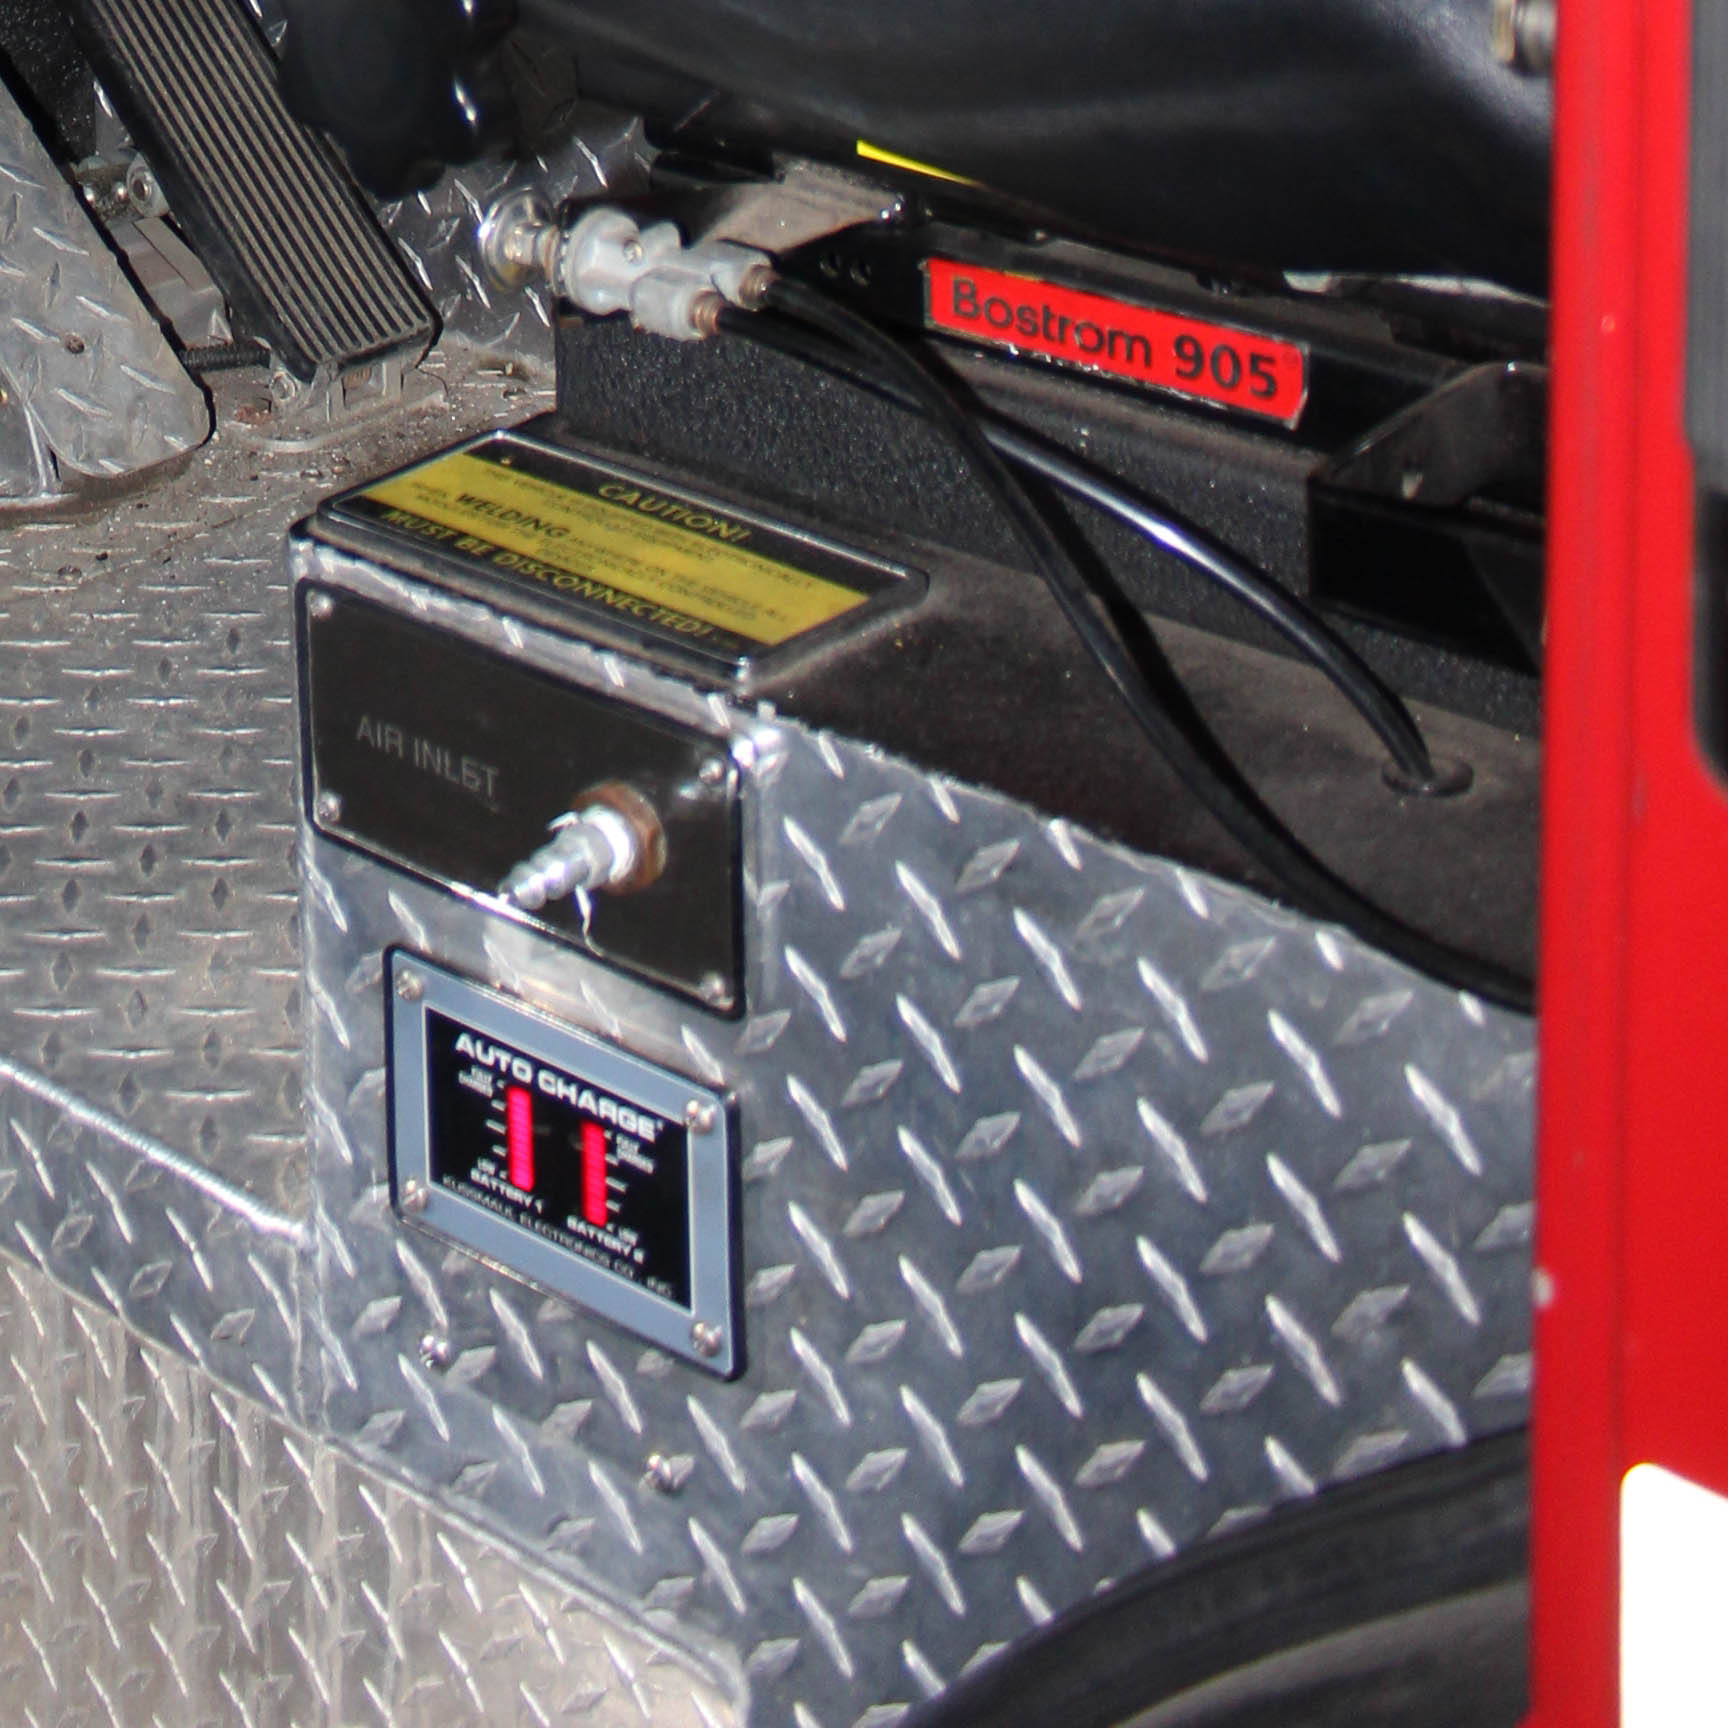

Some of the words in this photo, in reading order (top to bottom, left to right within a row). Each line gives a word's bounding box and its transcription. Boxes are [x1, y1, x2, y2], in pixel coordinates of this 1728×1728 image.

[952, 276, 1152, 368] Bostrom
[1173, 334, 1278, 398] 905
[455, 492, 570, 539] WELDING
[598, 483, 753, 543] CAUTION!
[379, 508, 458, 541] MUST
[455, 536, 497, 556] BE
[492, 551, 715, 638] DISCONNECTED!
[356, 714, 404, 760] AIR
[455, 1032, 533, 1084] AUTO
[471, 1168, 533, 1208] BATTERY
[567, 1215, 632, 1257] BATTERY
